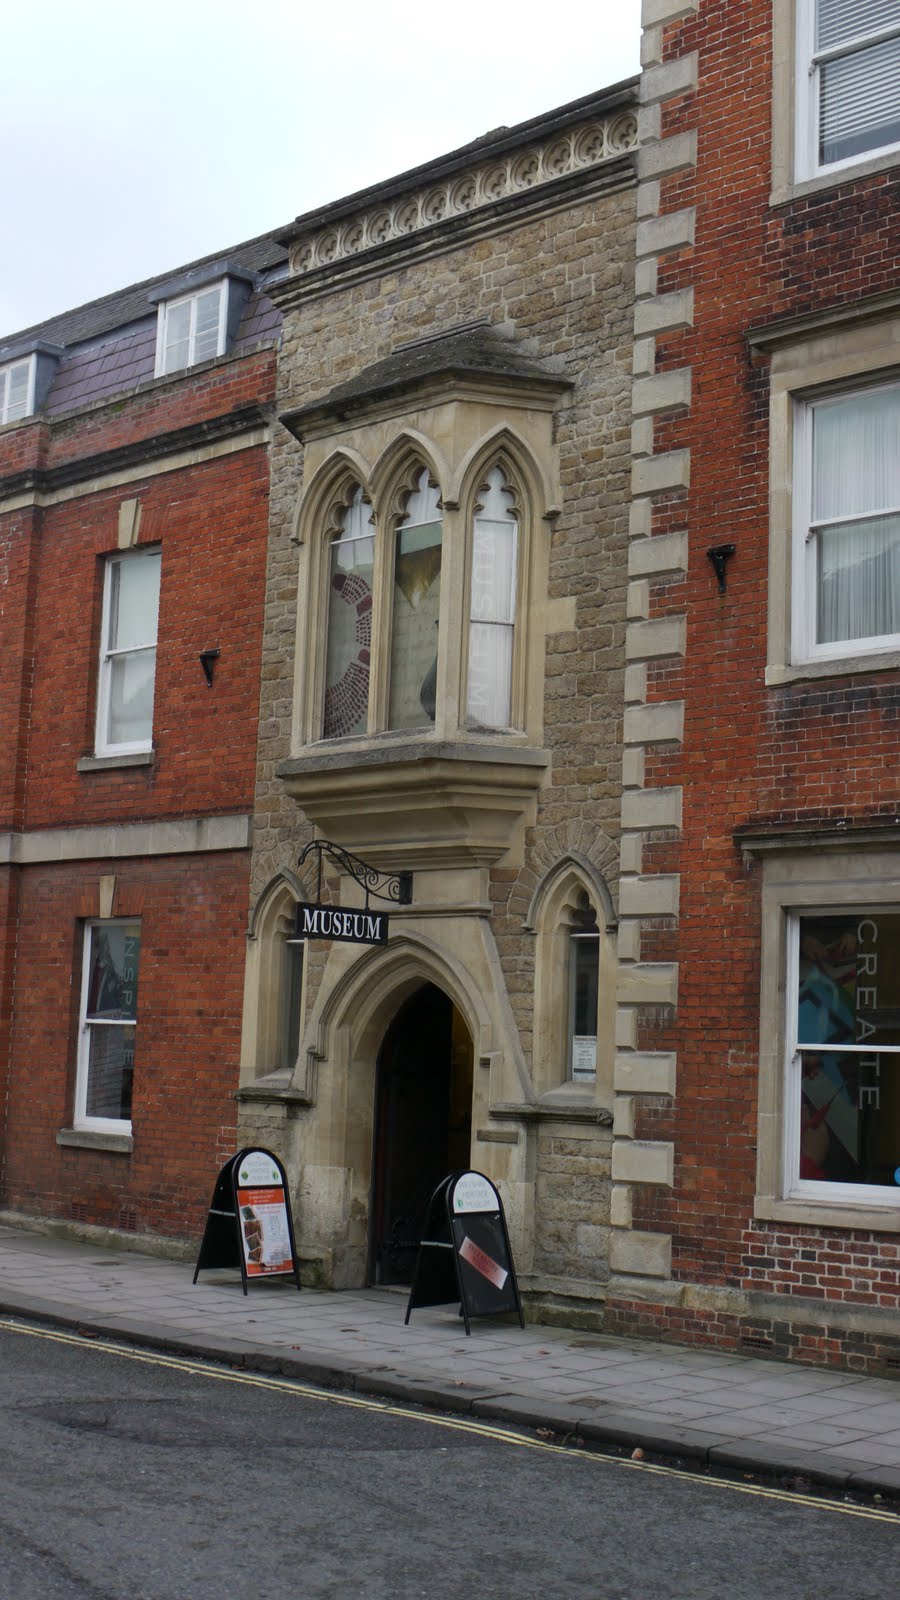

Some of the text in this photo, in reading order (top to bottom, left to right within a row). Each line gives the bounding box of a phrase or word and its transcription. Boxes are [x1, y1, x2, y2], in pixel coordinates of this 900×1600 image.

[470, 530, 496, 706] MUSEUM
[302, 909, 382, 940] MUSEUM
[857, 919, 880, 1109] CREATE
